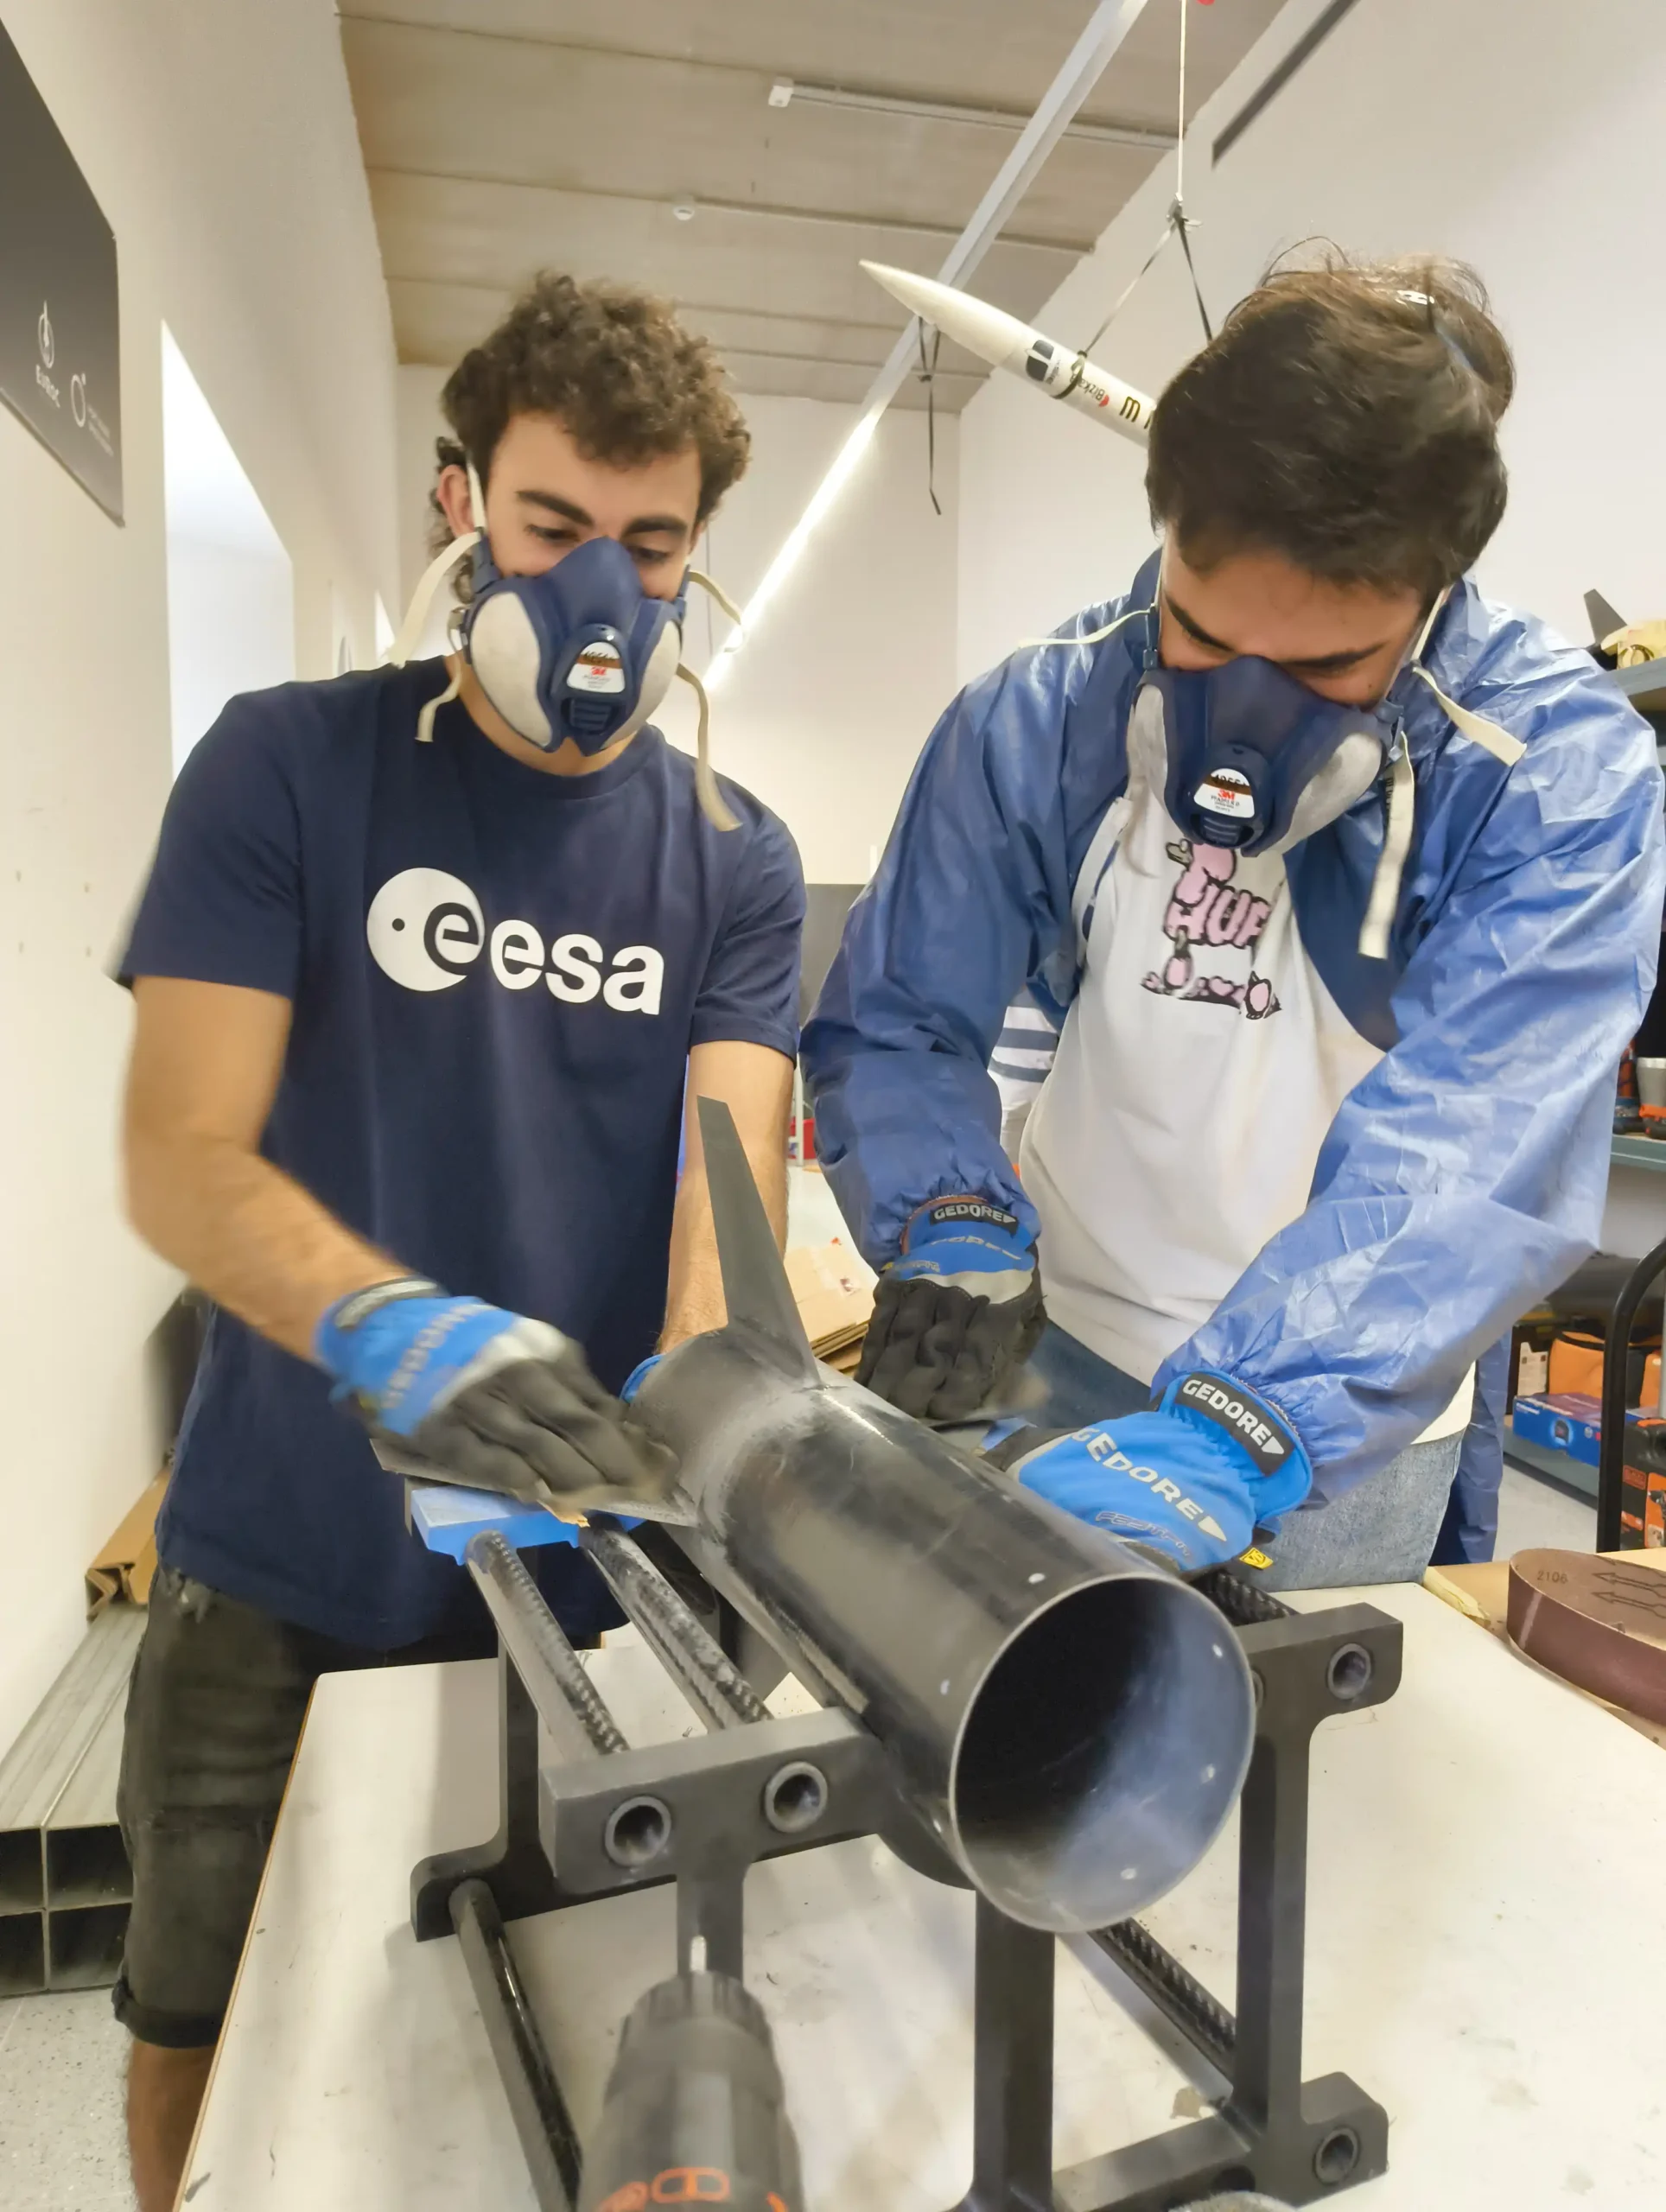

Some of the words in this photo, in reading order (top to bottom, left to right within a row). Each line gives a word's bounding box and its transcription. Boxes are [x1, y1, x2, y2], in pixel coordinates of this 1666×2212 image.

[1070, 373, 1106, 402] Bizkaa
[933, 1205, 1003, 1223] GEDORE
[1182, 1379, 1275, 1446] GEDORE
[1071, 1427, 1205, 1520] GEDORE
